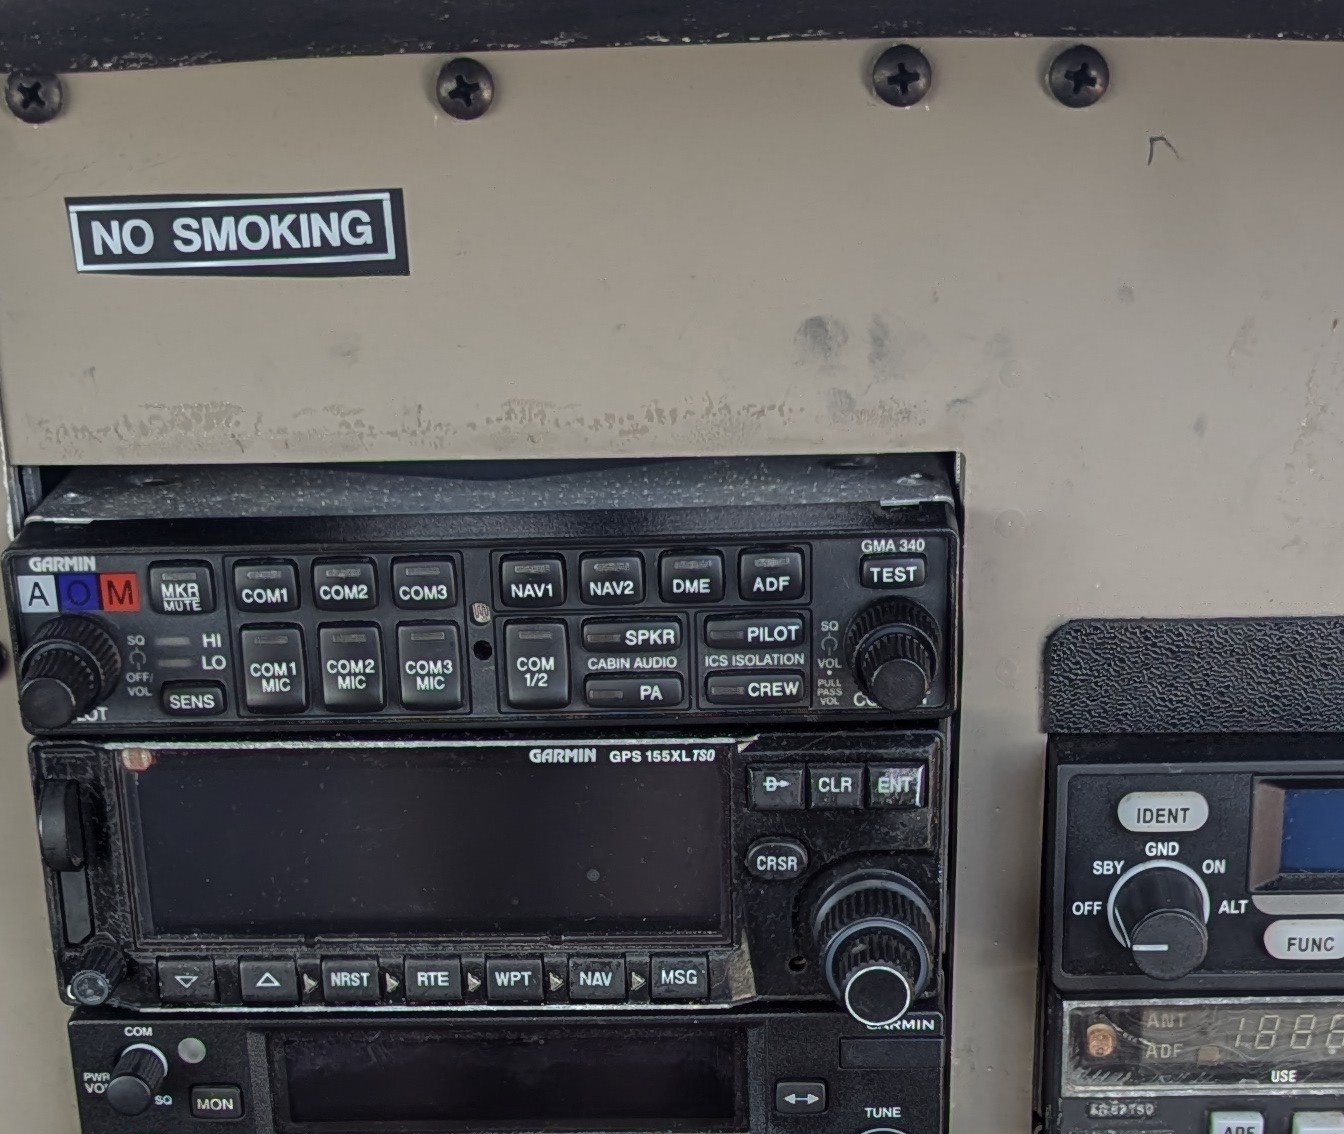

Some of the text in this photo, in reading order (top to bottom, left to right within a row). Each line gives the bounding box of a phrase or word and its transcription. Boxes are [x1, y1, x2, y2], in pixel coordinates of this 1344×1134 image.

[91, 210, 373, 256] NO SMOKING
[861, 539, 925, 553] GMA 340
[29, 556, 97, 572] GARMIN
[870, 566, 918, 583] TEST
[161, 582, 199, 598] MKR
[319, 585, 368, 600] COM2
[510, 582, 553, 599] NAV1
[589, 580, 635, 597] NAV2
[672, 579, 710, 594] DME
[753, 576, 790, 593] ADF
[241, 588, 288, 604] COM1
[399, 586, 448, 601] COM3
[163, 600, 201, 612] MUTE
[202, 633, 222, 648] HI
[624, 629, 675, 646] SPKR
[747, 625, 799, 643] PILOT
[202, 655, 226, 671] LO
[588, 654, 678, 670] CABIN AUDIO
[704, 653, 805, 667] ICS ISOLATION
[639, 685, 664, 701] PA
[747, 682, 800, 697] CREW
[169, 694, 215, 710] SENS
[529, 748, 641, 764] GARMIN GPS
[818, 777, 852, 793] CLR
[1136, 807, 1191, 825] IDENT
[1145, 841, 1180, 858] GND
[755, 855, 798, 872] CRSR
[1092, 860, 1125, 876] SBY
[1072, 900, 1102, 916] OFF
[1219, 899, 1249, 915] ALT
[1286, 936, 1335, 953] FUNC
[330, 971, 370, 987] NRST
[416, 971, 449, 987] RTE
[495, 971, 532, 987] WPT
[578, 971, 612, 987] NAV
[660, 969, 698, 985] MSG
[1270, 1069, 1297, 1084] USE
[196, 1098, 234, 1111] MON
[865, 1106, 901, 1119] TUNE
